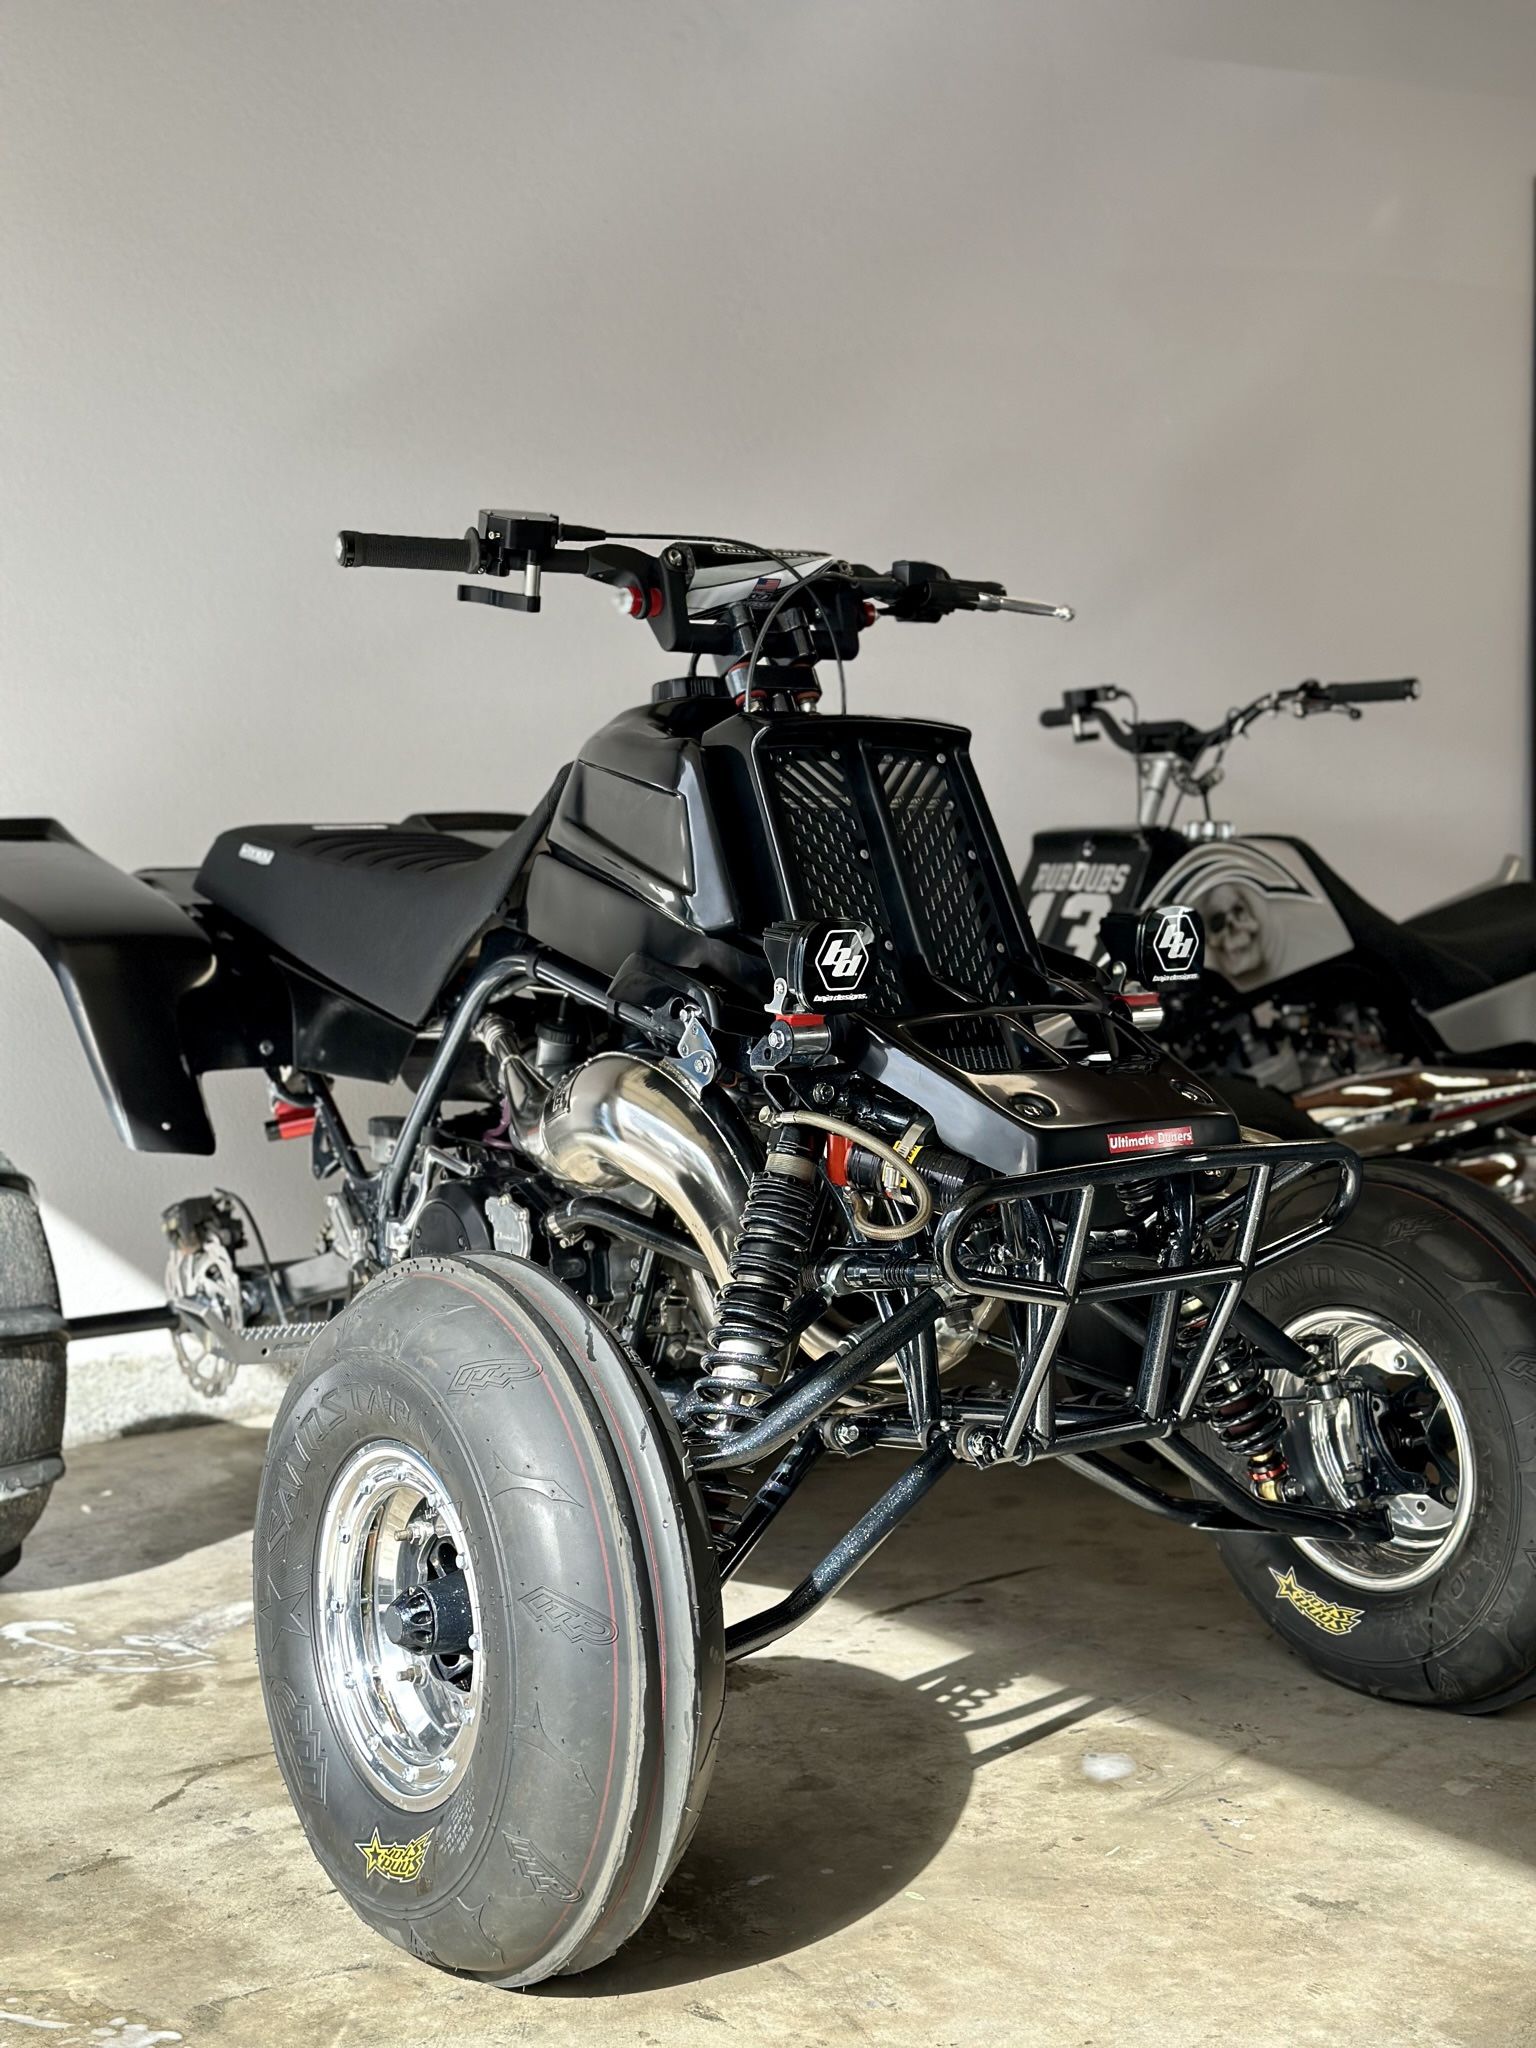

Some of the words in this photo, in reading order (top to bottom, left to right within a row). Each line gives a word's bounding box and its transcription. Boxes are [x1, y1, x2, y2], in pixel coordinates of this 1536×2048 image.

[1032, 861, 1131, 894] RUBDUBS
[813, 994, 833, 1002] baja
[1110, 1133, 1155, 1149] Ultimate
[1157, 1131, 1193, 1144] Duners
[448, 1359, 543, 1395] ITP
[518, 1585, 619, 1646] ITP
